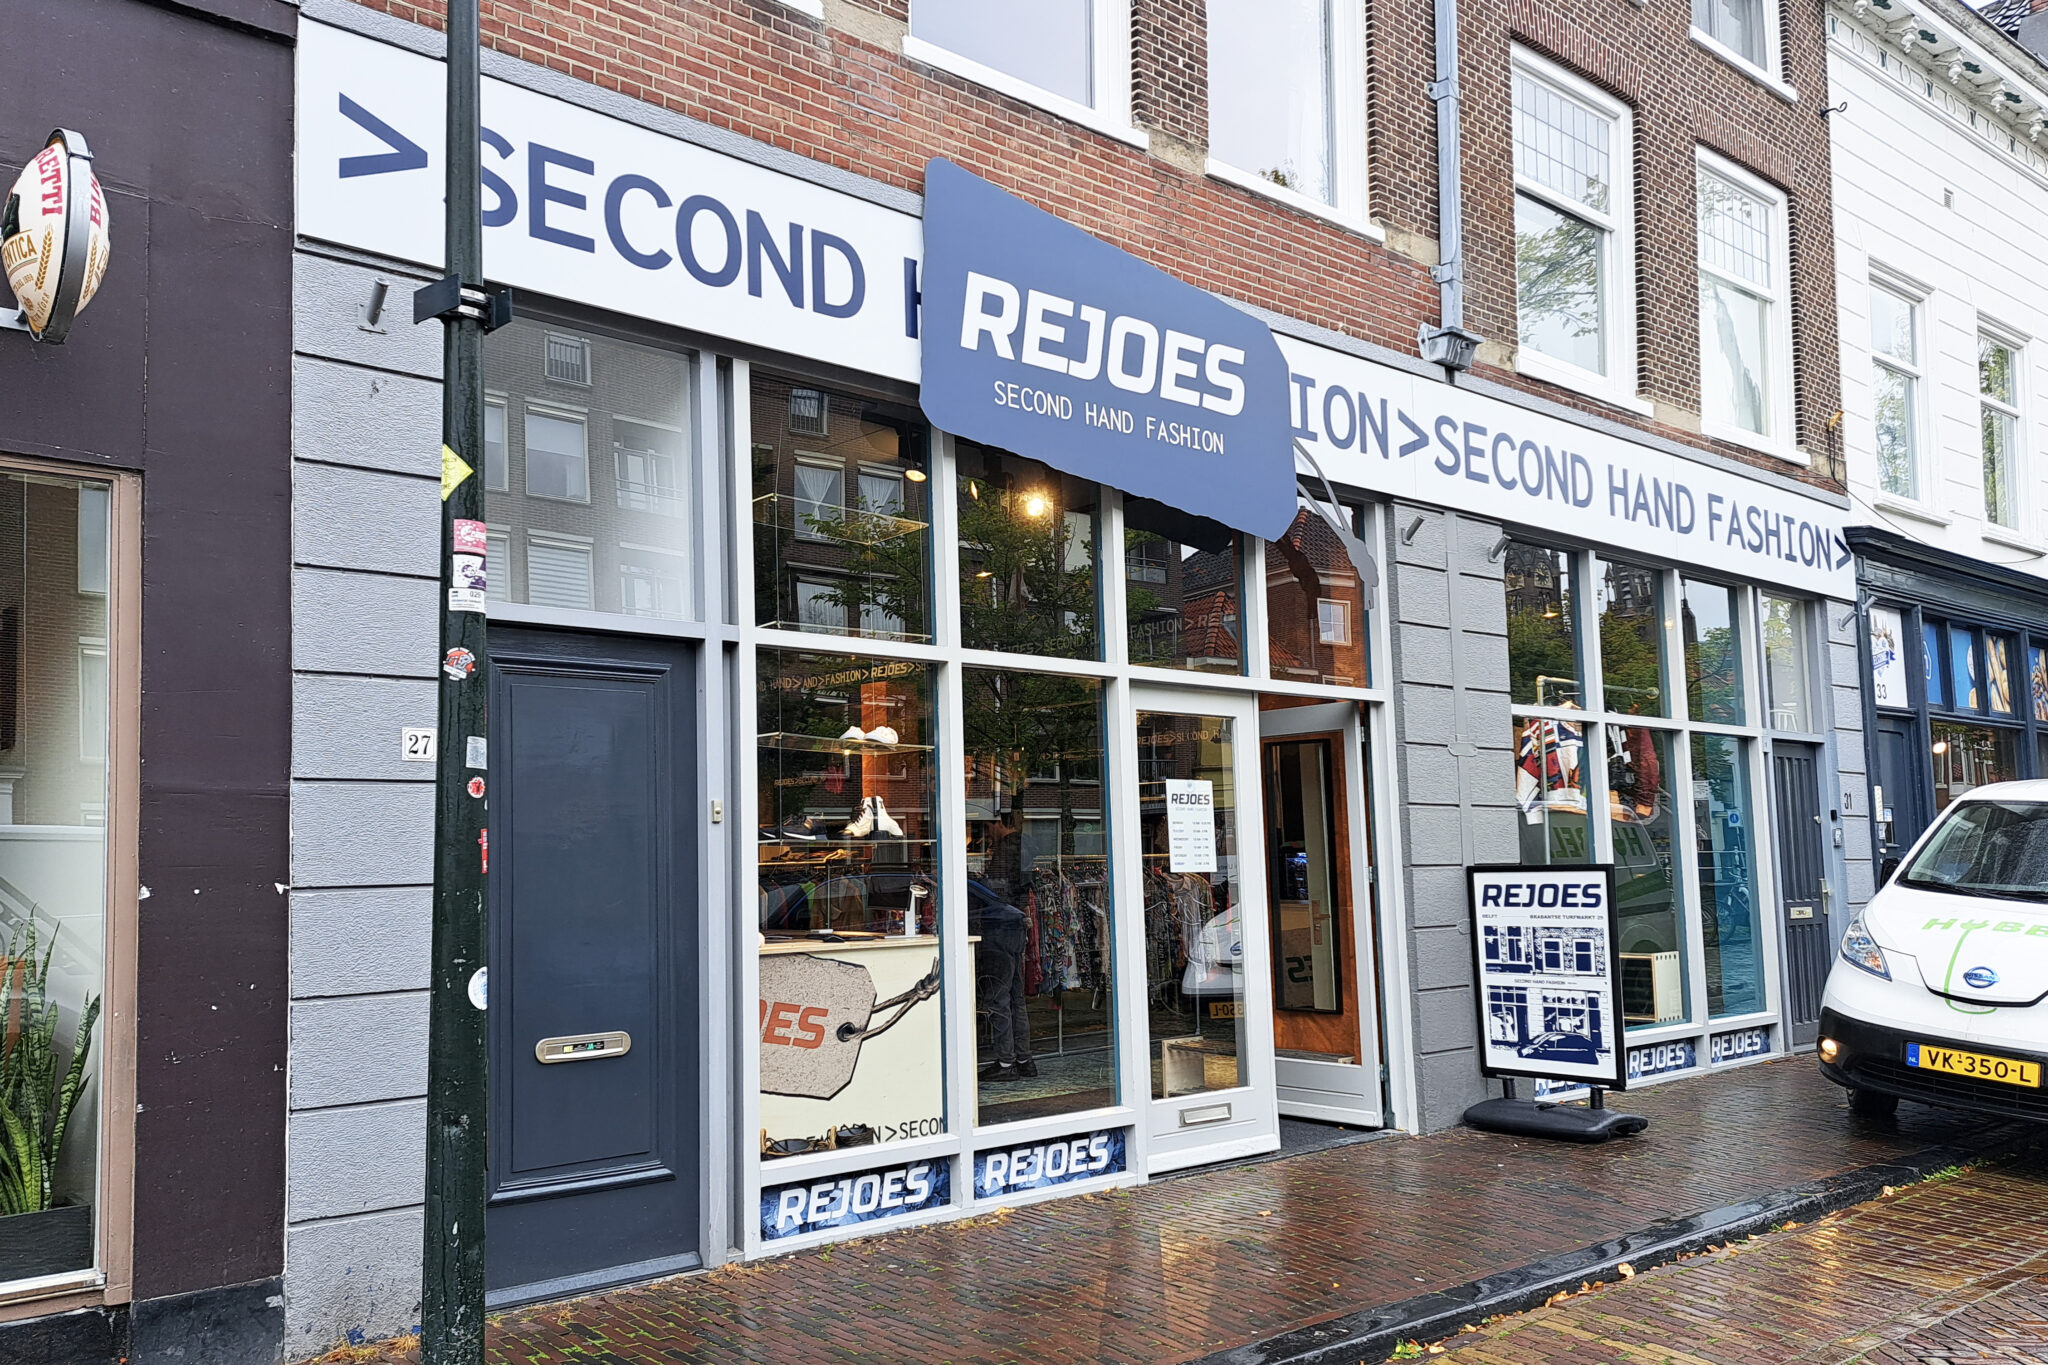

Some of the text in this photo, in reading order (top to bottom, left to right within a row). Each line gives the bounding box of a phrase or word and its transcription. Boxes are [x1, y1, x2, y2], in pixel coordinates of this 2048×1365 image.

[959, 271, 1246, 416] REJOES
[993, 381, 1225, 455] SECOND HAND FASHION
[1608, 464, 1695, 534] HAND
[1876, 683, 1888, 700] 33
[408, 734, 431, 755] 27
[1171, 793, 1210, 805] REJOES
[1844, 792, 1853, 810] 31
[1482, 883, 1602, 908] REJOES
[1628, 1043, 1685, 1073] REJOES
[1711, 1029, 1761, 1058] REJOES
[984, 1135, 1109, 1190] REJOES
[776, 1165, 931, 1230] REJOES
